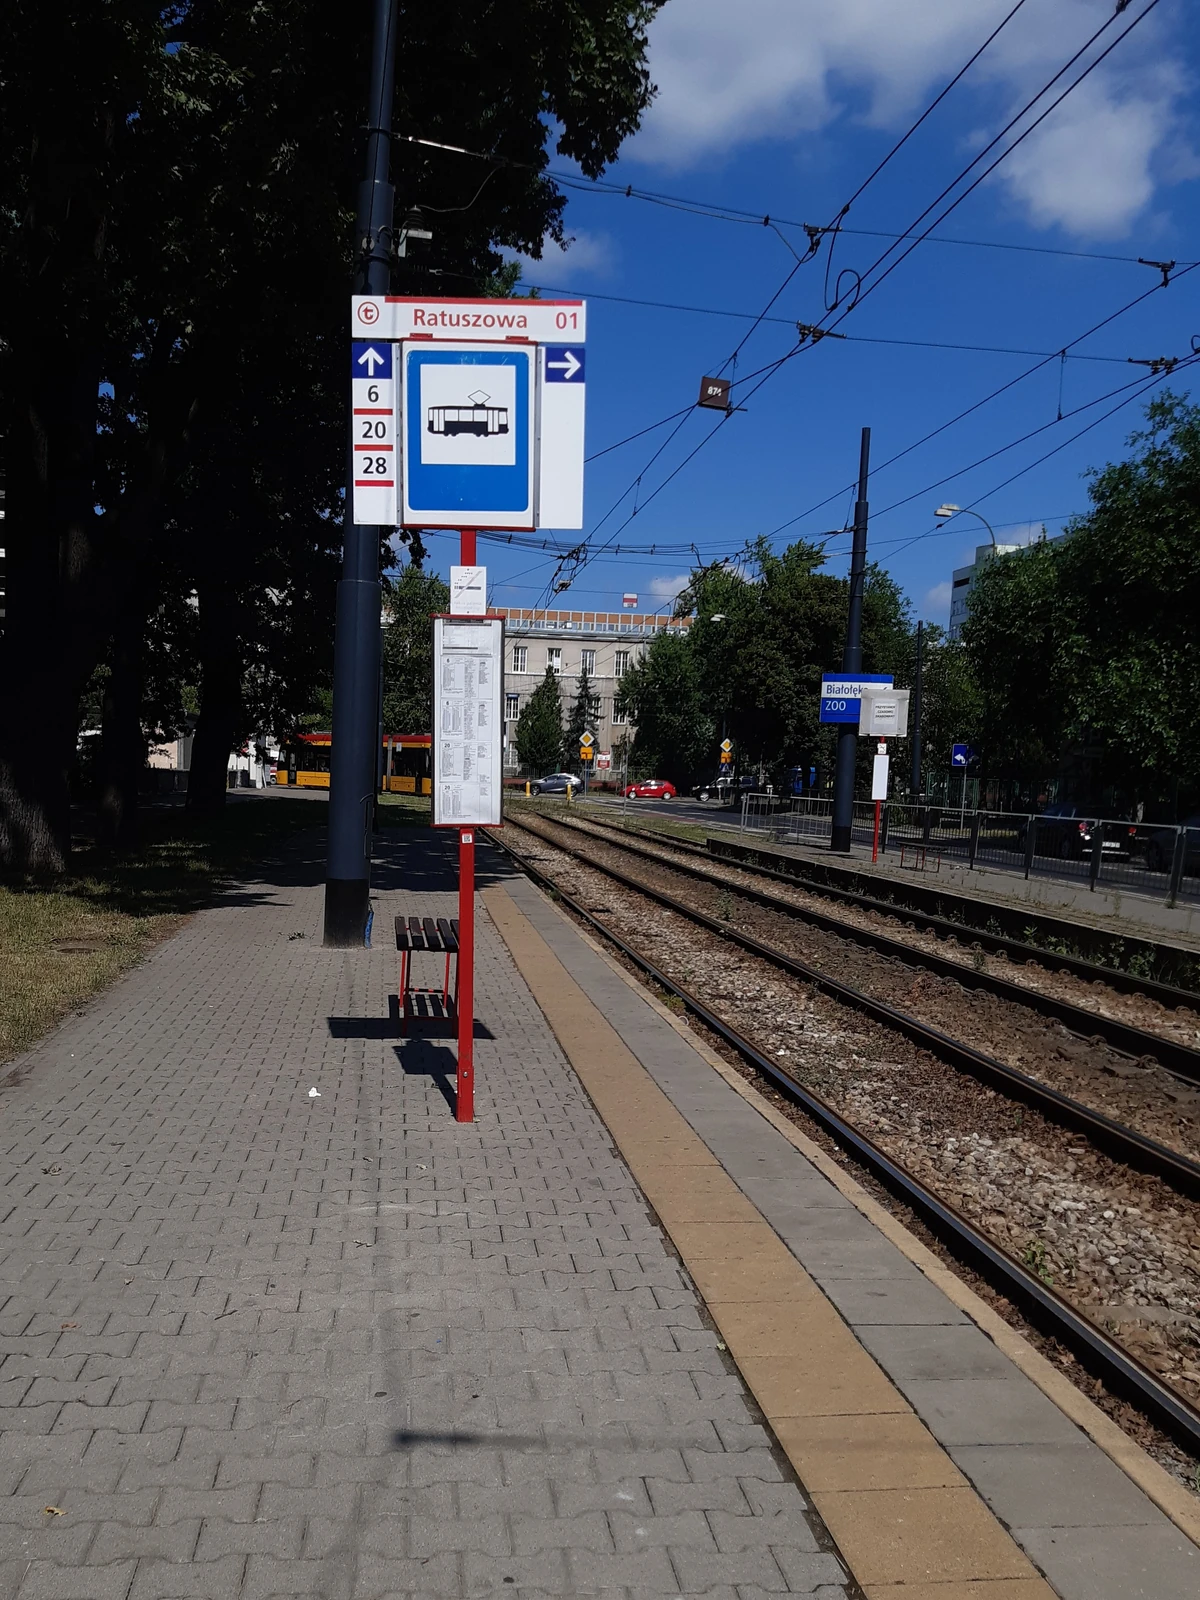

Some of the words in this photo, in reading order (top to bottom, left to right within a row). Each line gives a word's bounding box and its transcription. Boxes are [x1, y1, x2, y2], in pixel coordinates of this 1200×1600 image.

[413, 308, 527, 329] Ratuszowa
[555, 312, 578, 330] 01
[367, 385, 379, 403] 6
[361, 421, 386, 439] 20
[362, 456, 387, 475] 28
[826, 684, 868, 697] Białołęk
[825, 700, 846, 711] ZOO
